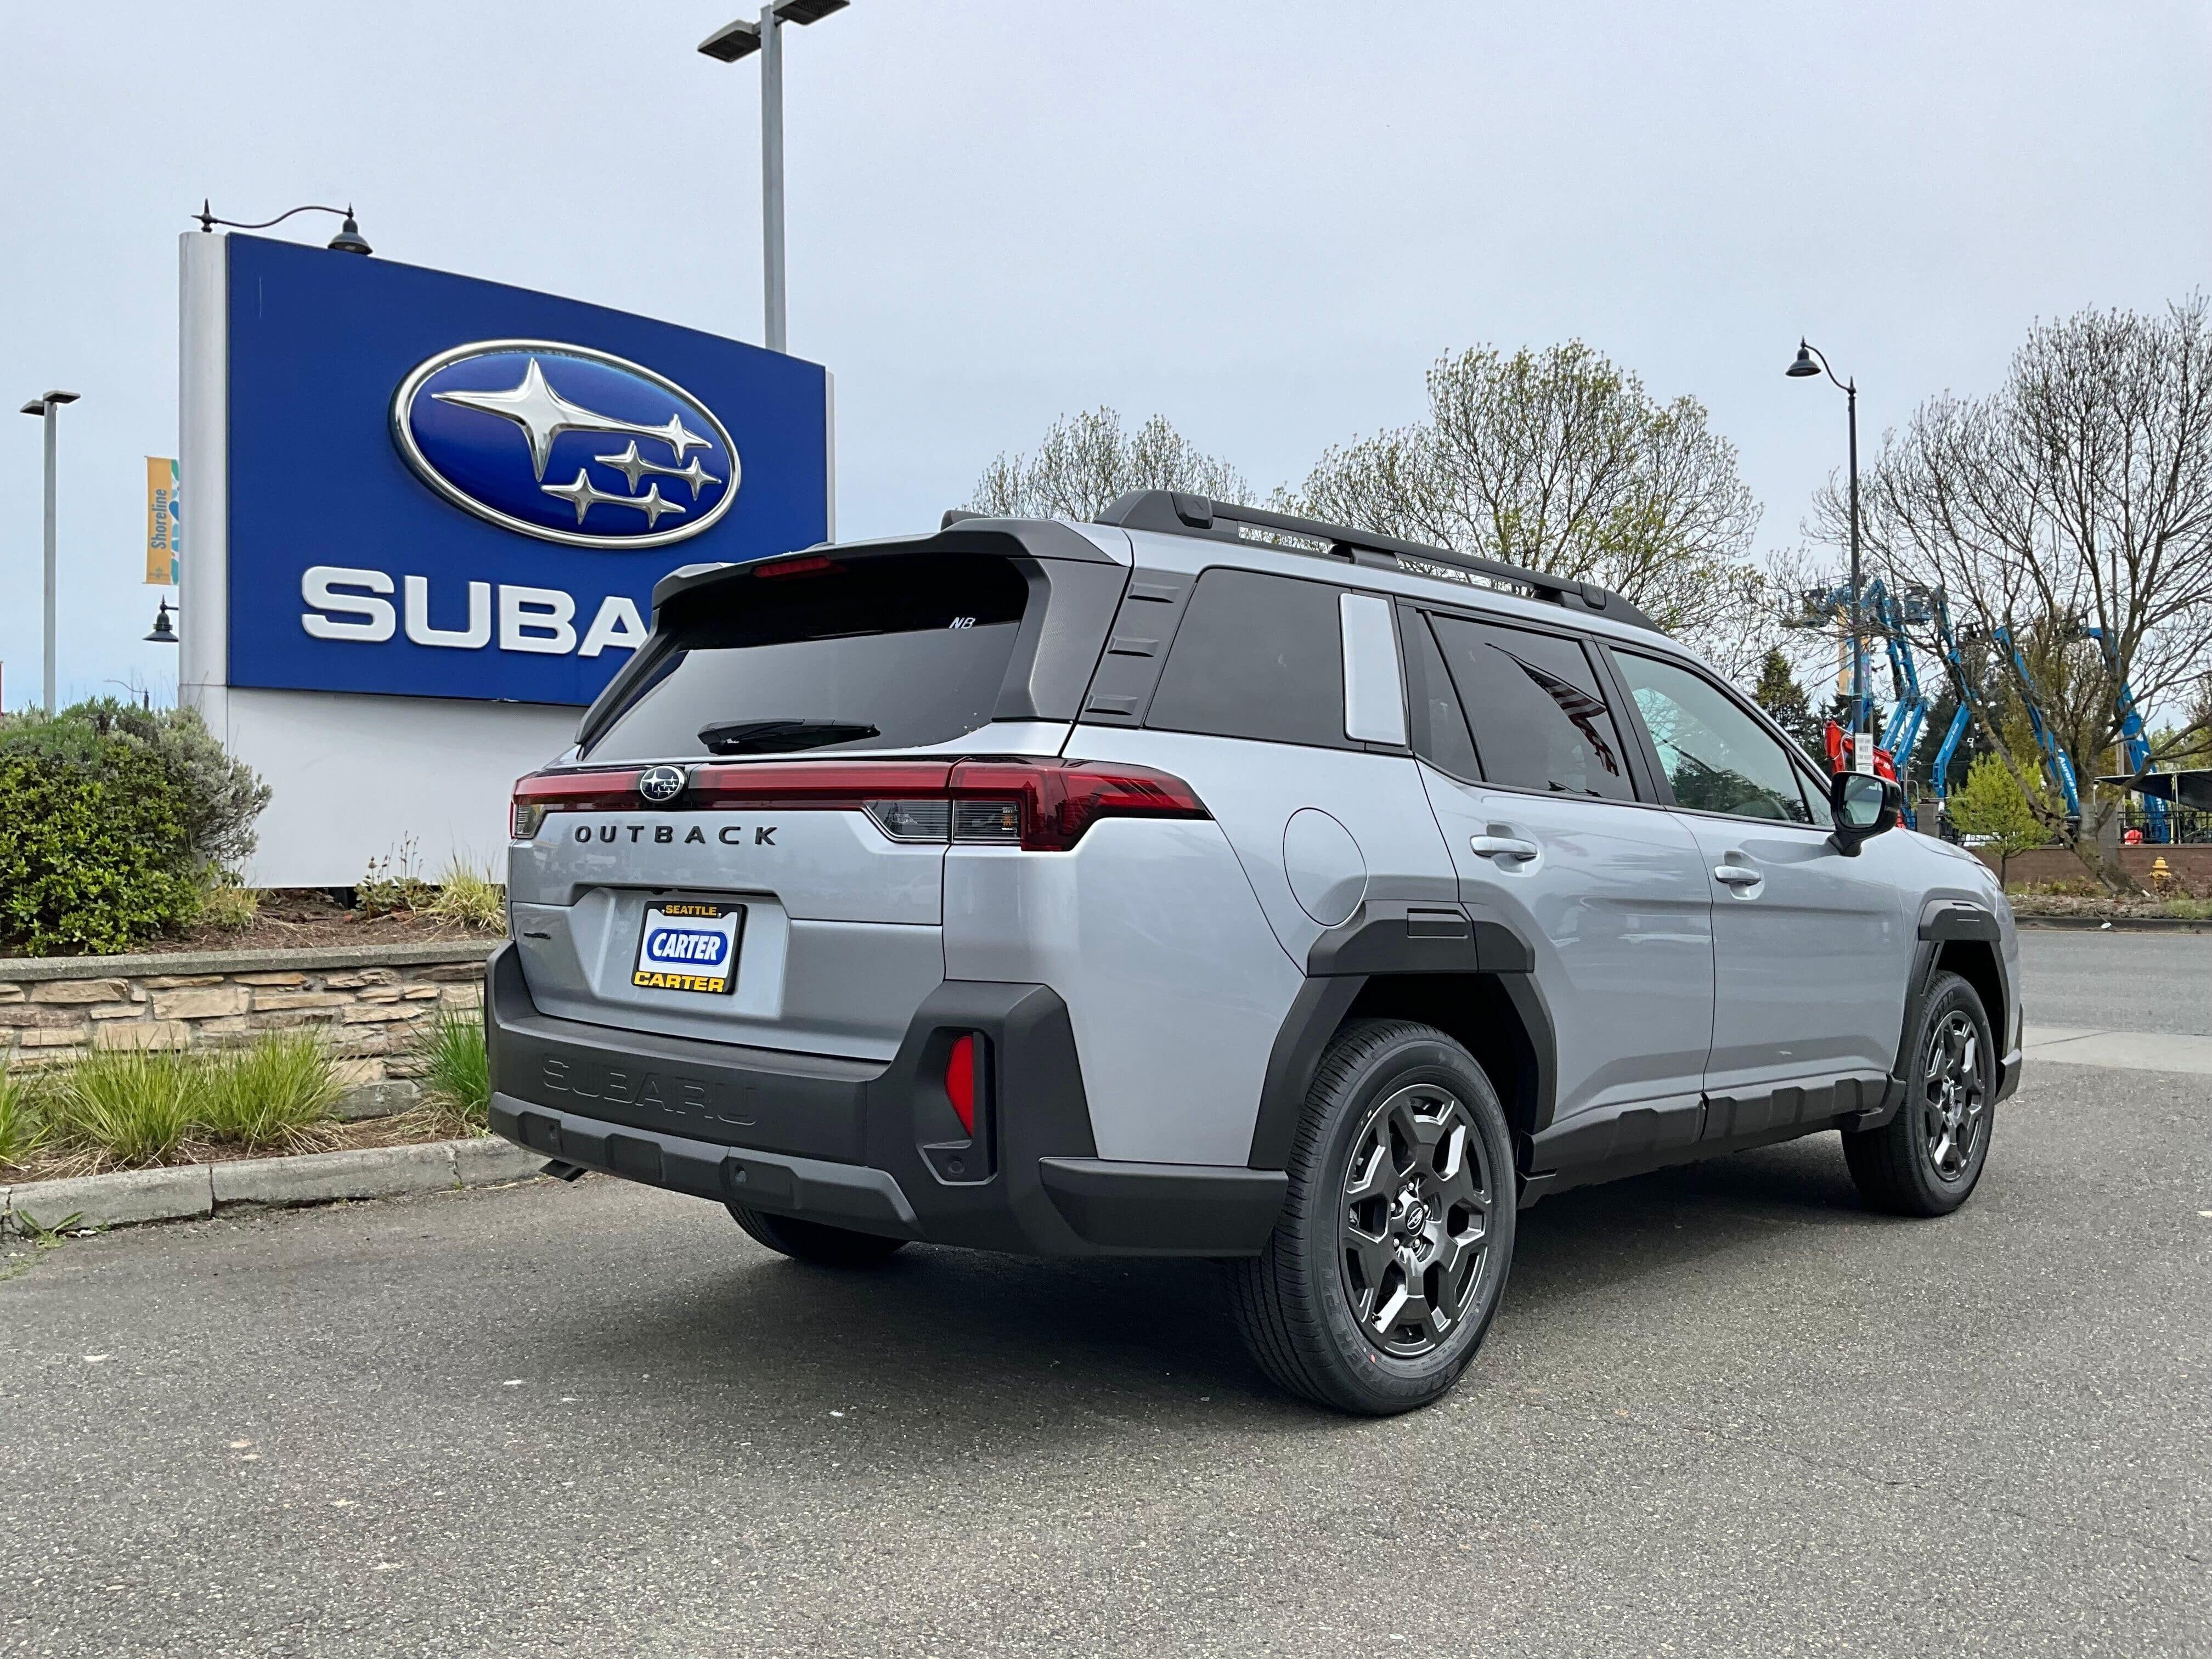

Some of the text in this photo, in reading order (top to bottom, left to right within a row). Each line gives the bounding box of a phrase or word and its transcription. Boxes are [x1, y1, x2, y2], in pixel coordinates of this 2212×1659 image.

[151, 488, 167, 550] Shoreline
[301, 565, 649, 657] SUBA
[949, 617, 976, 629] NB
[574, 825, 777, 845] OUTBACK
[665, 905, 717, 916] SEATTLE
[652, 932, 721, 961] CARTER
[634, 971, 724, 992] CARTER
[543, 1052, 758, 1126] SUBARU
